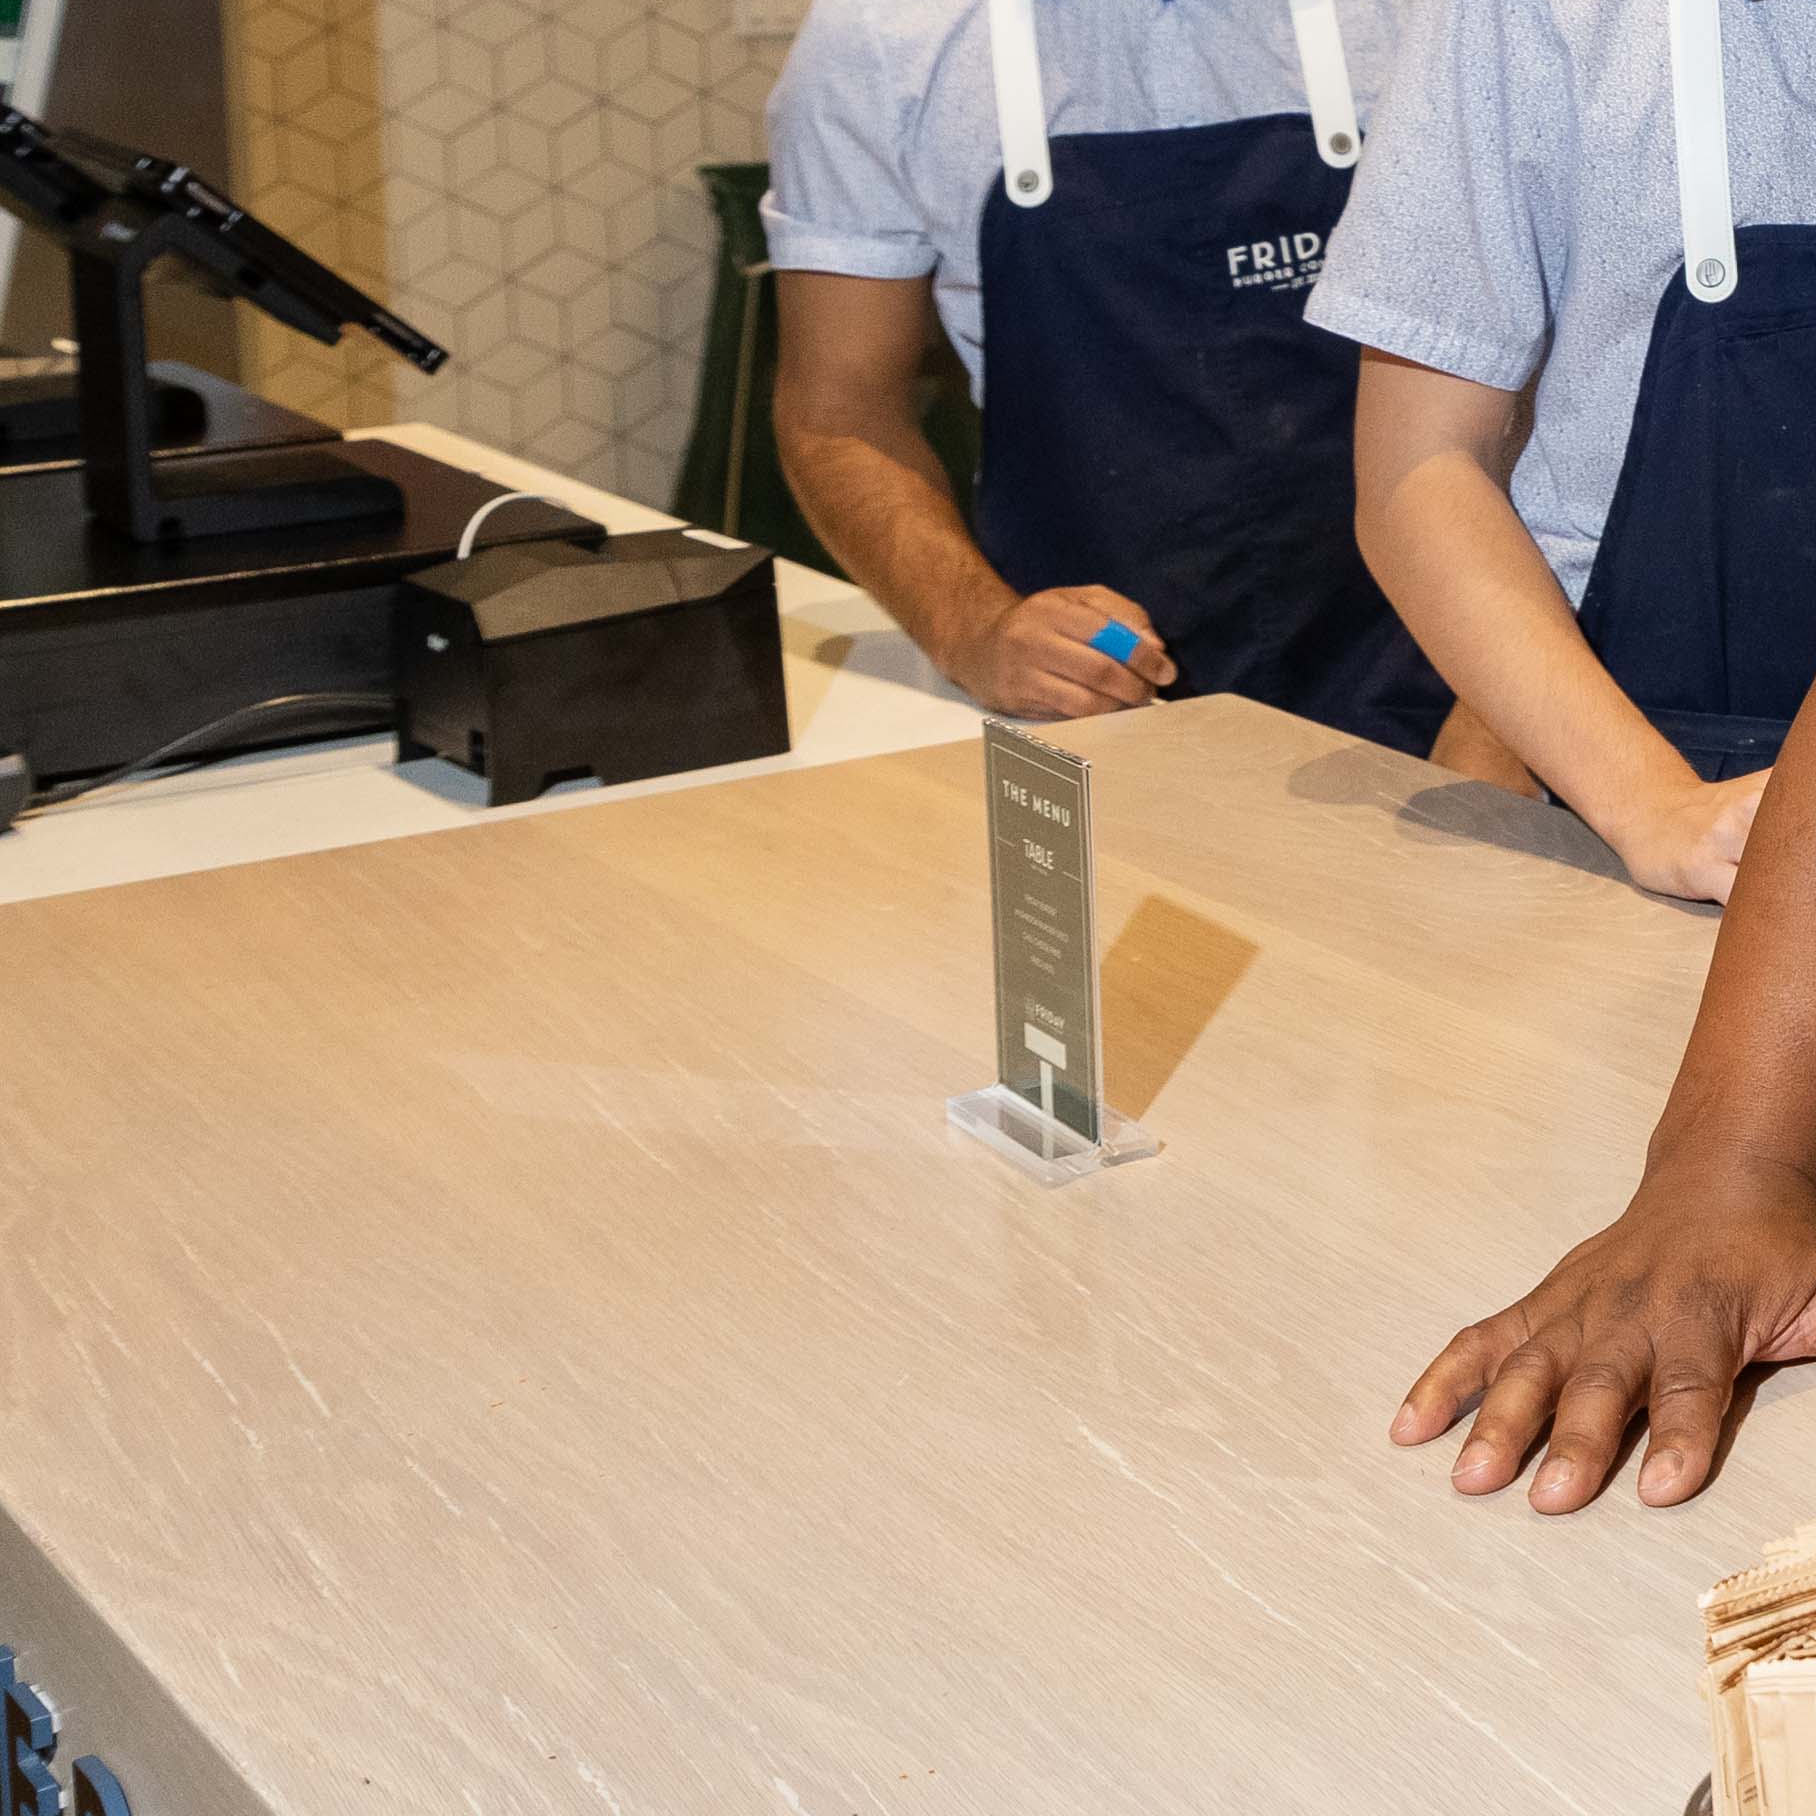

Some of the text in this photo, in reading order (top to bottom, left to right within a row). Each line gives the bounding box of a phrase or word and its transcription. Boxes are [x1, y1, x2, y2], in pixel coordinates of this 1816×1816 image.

[1227, 232, 1321, 276] FRID
[1002, 779, 1071, 827] THE MENU
